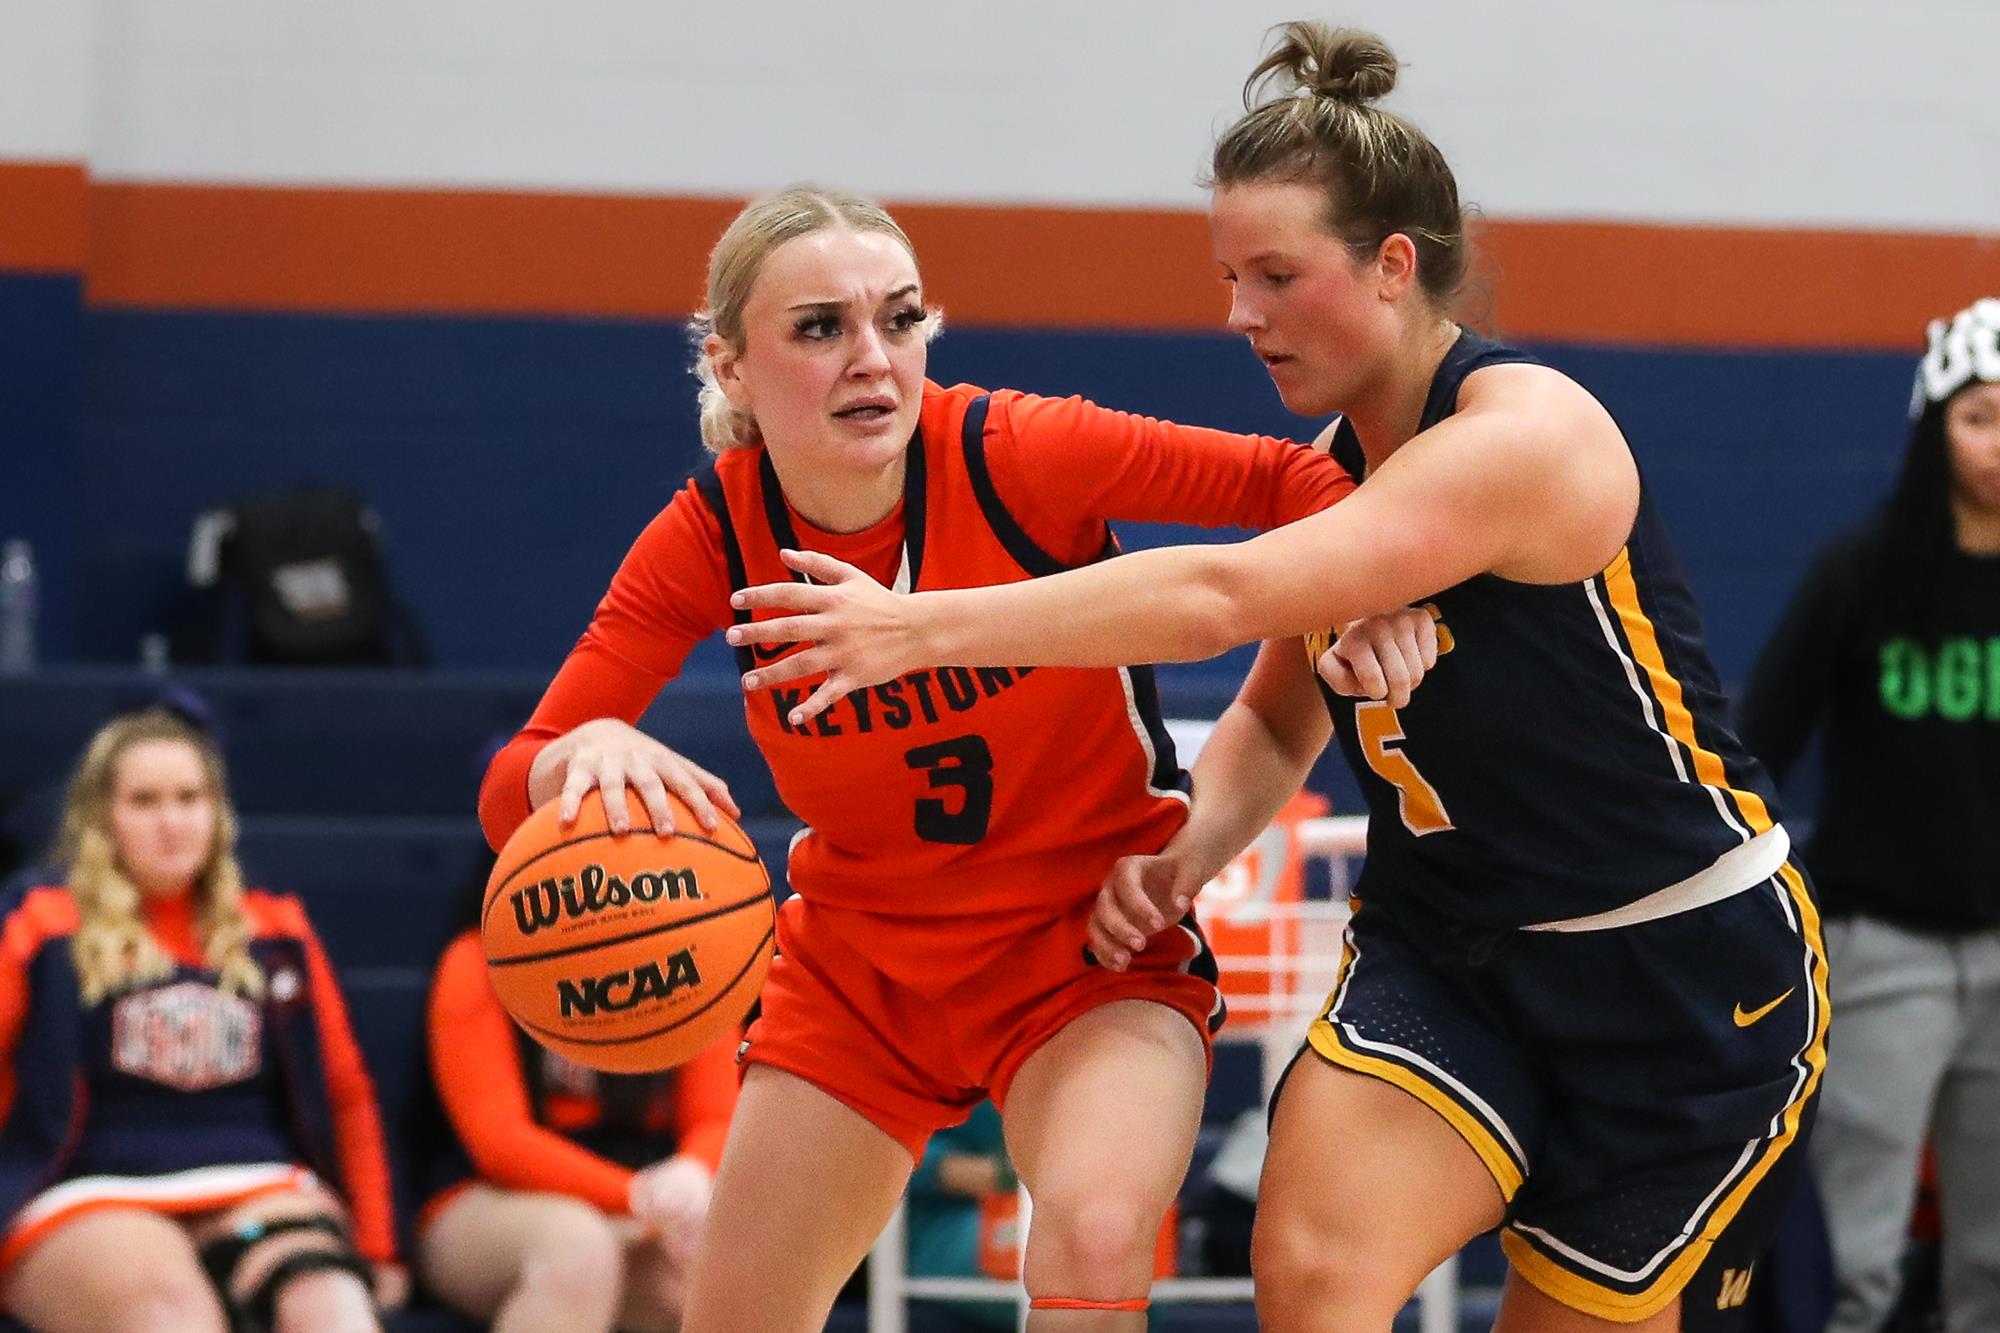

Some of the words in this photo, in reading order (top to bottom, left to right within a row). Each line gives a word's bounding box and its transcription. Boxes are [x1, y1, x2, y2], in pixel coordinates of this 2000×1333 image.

[771, 666, 1038, 737] KEYSTON
[904, 734, 994, 846] 3
[1355, 700, 1457, 838] 5
[510, 864, 702, 935] Wilson
[556, 946, 702, 1018] NCAA
